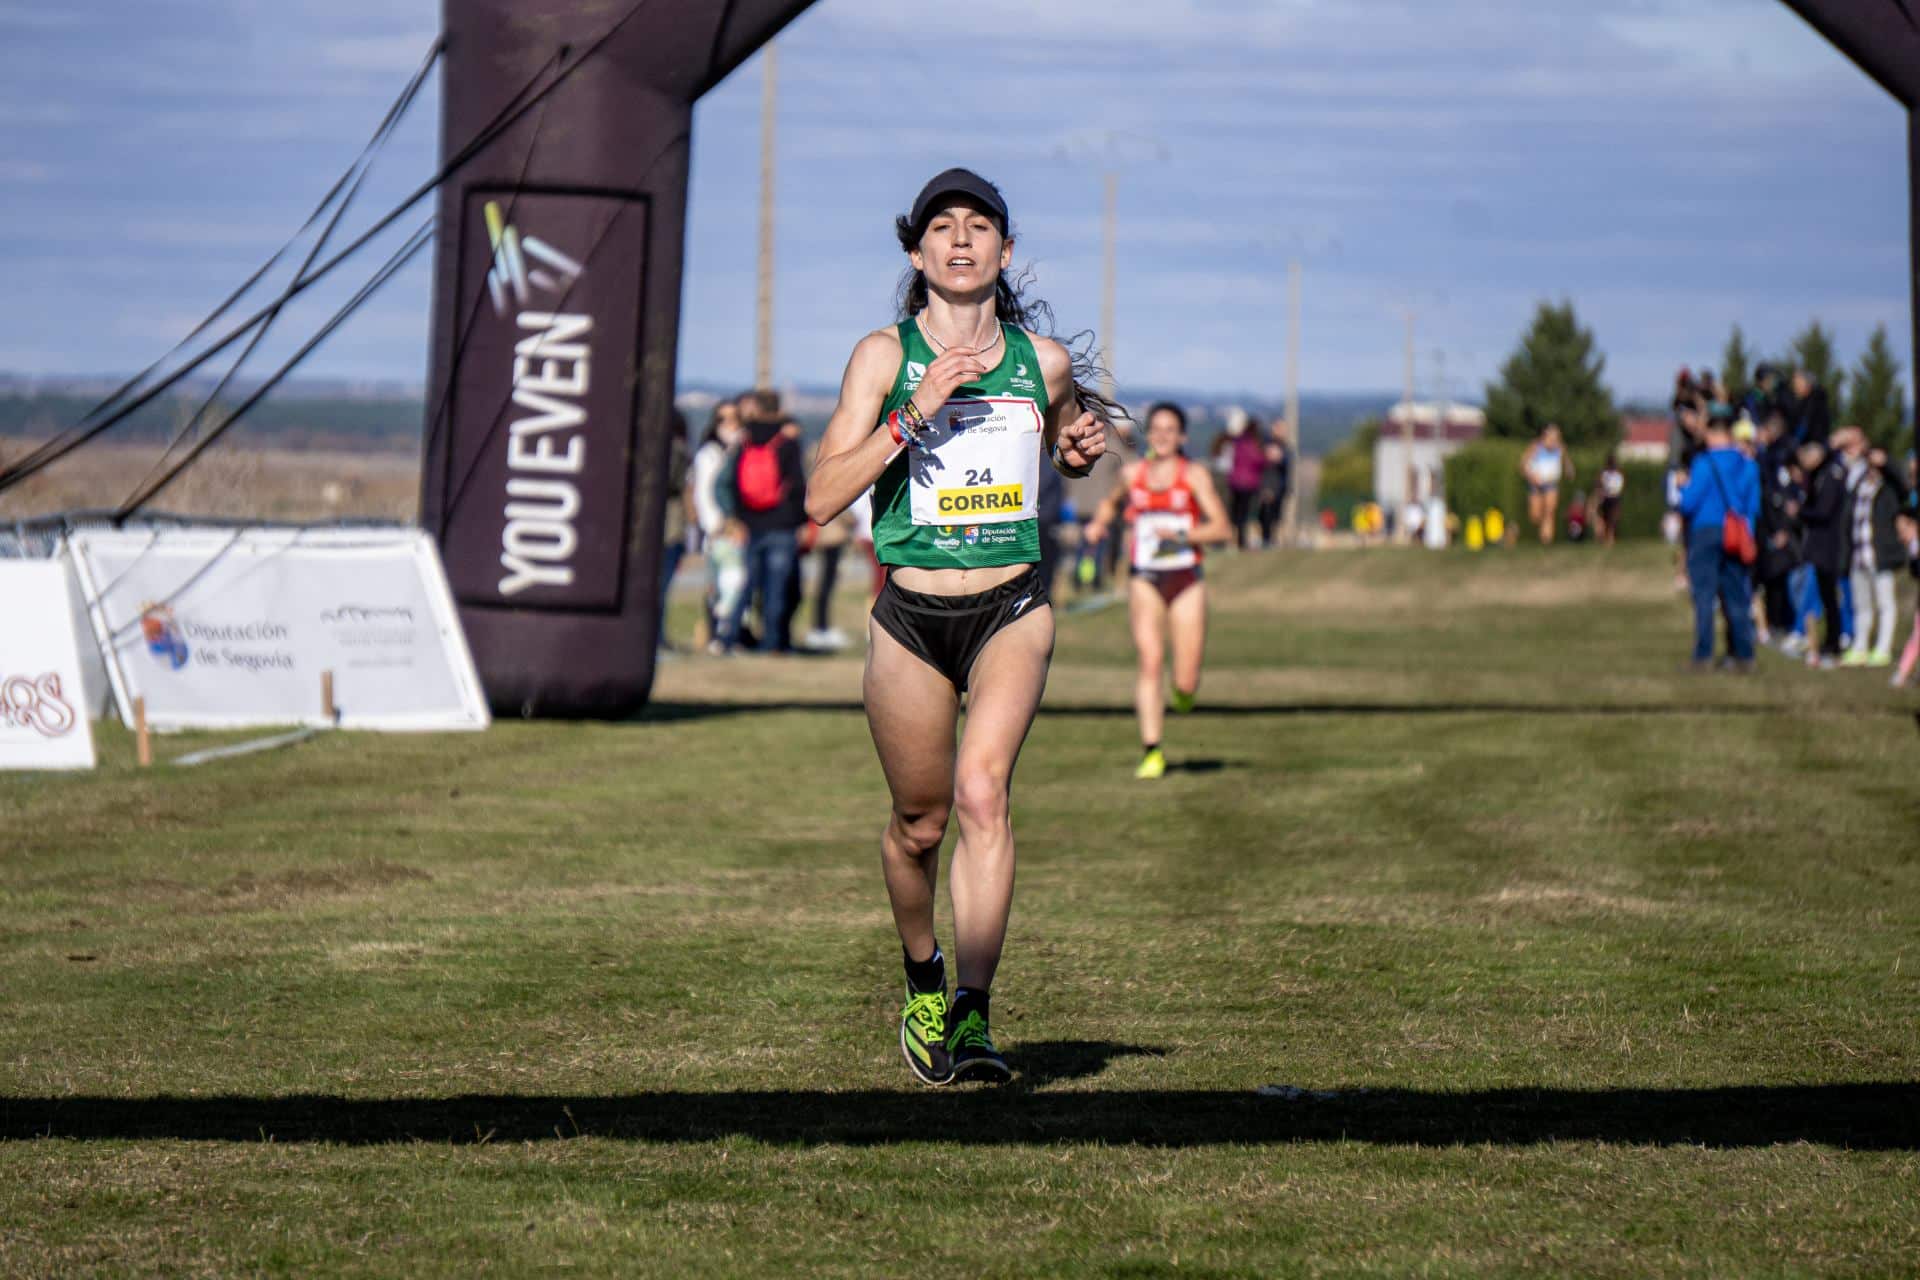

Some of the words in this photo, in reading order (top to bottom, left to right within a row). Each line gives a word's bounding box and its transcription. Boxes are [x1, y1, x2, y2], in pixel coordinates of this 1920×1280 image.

[979, 425, 1007, 435] Segovia
[965, 468, 993, 486] 24
[939, 491, 1023, 511] CORRAL
[982, 528, 1016, 536] Diputación
[993, 535, 1016, 544] Segovia
[183, 620, 288, 642] Diputación
[195, 647, 218, 666] de
[221, 649, 293, 671] Segovia
